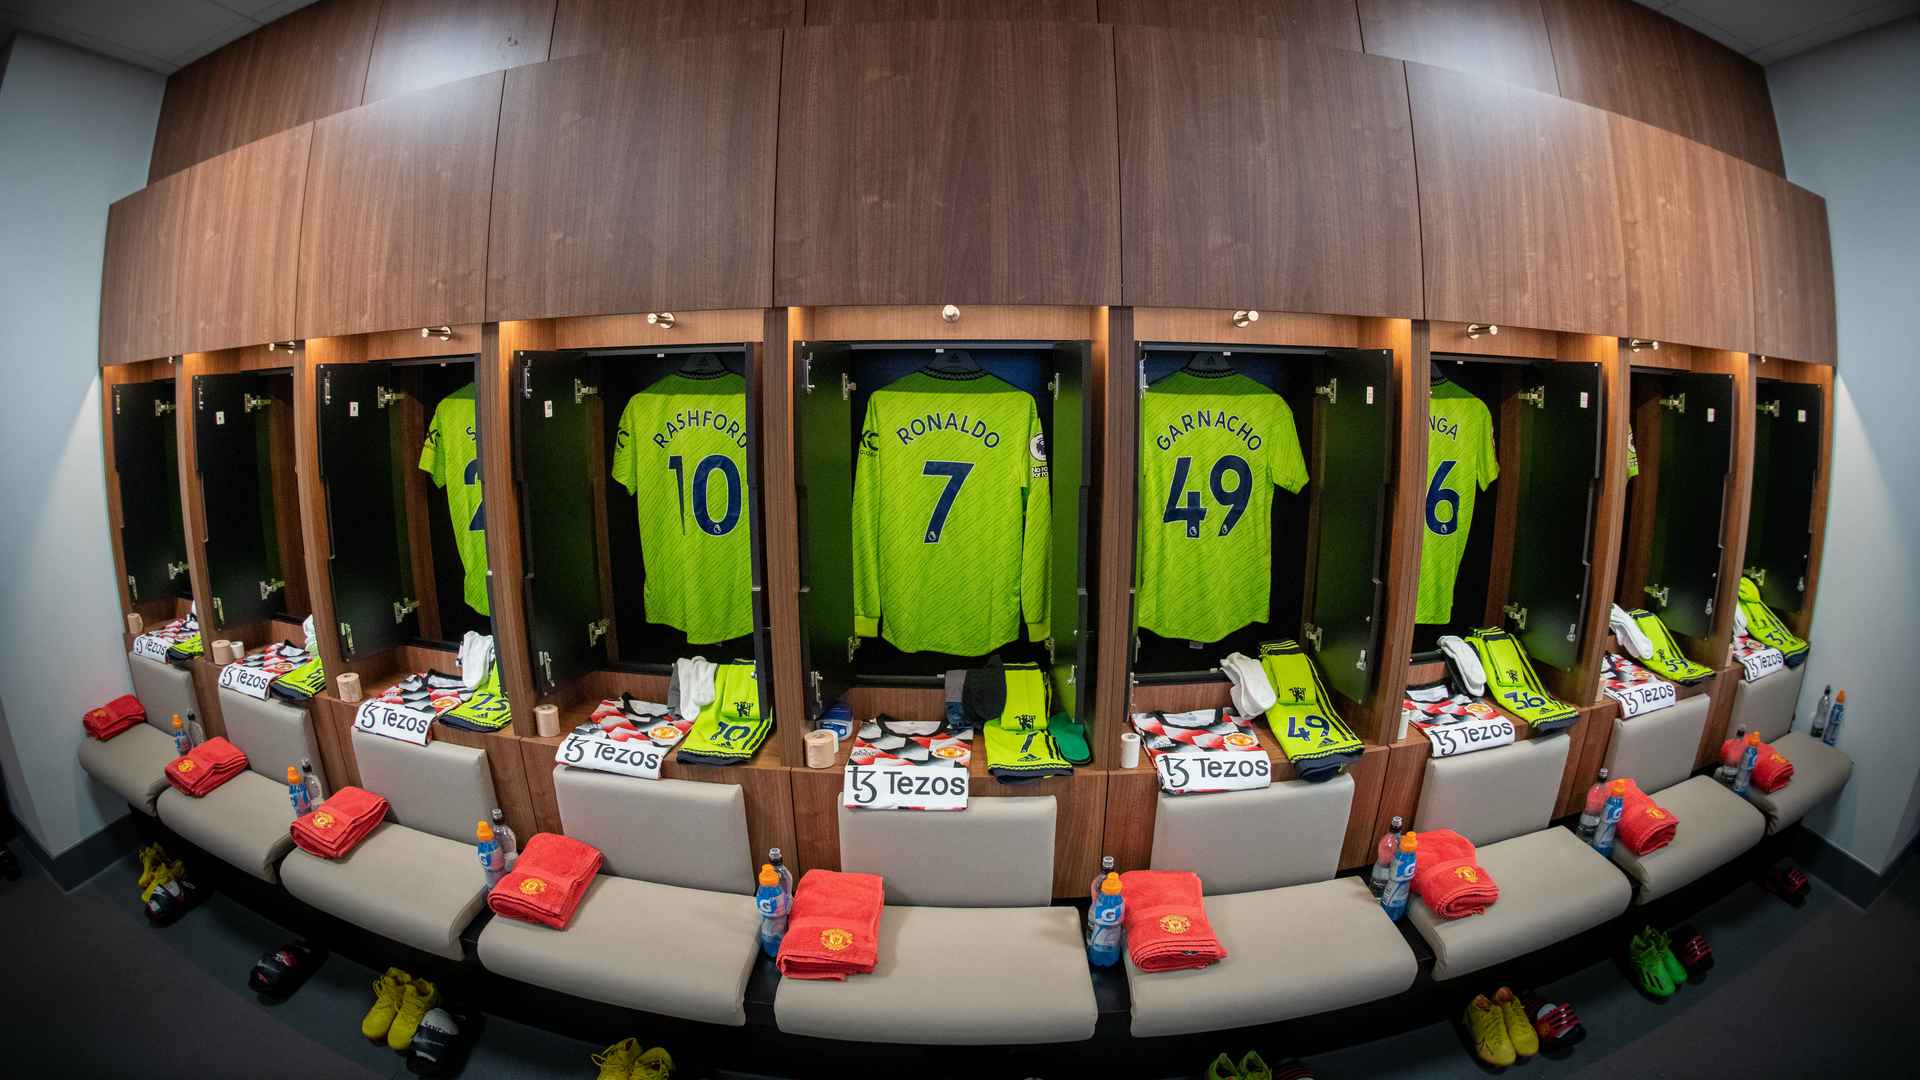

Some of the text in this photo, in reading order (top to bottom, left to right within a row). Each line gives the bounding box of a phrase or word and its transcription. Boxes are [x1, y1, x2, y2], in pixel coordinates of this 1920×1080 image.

[653, 410, 747, 448] RASHFORD
[896, 412, 1000, 449] RONALDO
[1156, 410, 1262, 451] GARNACHO
[668, 454, 742, 537] 10
[922, 460, 976, 544] 7
[1162, 455, 1253, 539] 49
[145, 638, 167, 657] Tezos
[1758, 652, 1783, 670] Tezos
[236, 669, 268, 690] Tezos
[1504, 690, 1546, 710] 36
[1637, 684, 1674, 704] Tezos
[382, 707, 428, 734] Tezos
[710, 721, 751, 742] 10
[1287, 715, 1330, 742] 49
[1454, 721, 1513, 744] Tezos
[593, 741, 660, 770] Tezos
[1192, 757, 1269, 778] Tezos
[883, 771, 966, 796] Tezos
